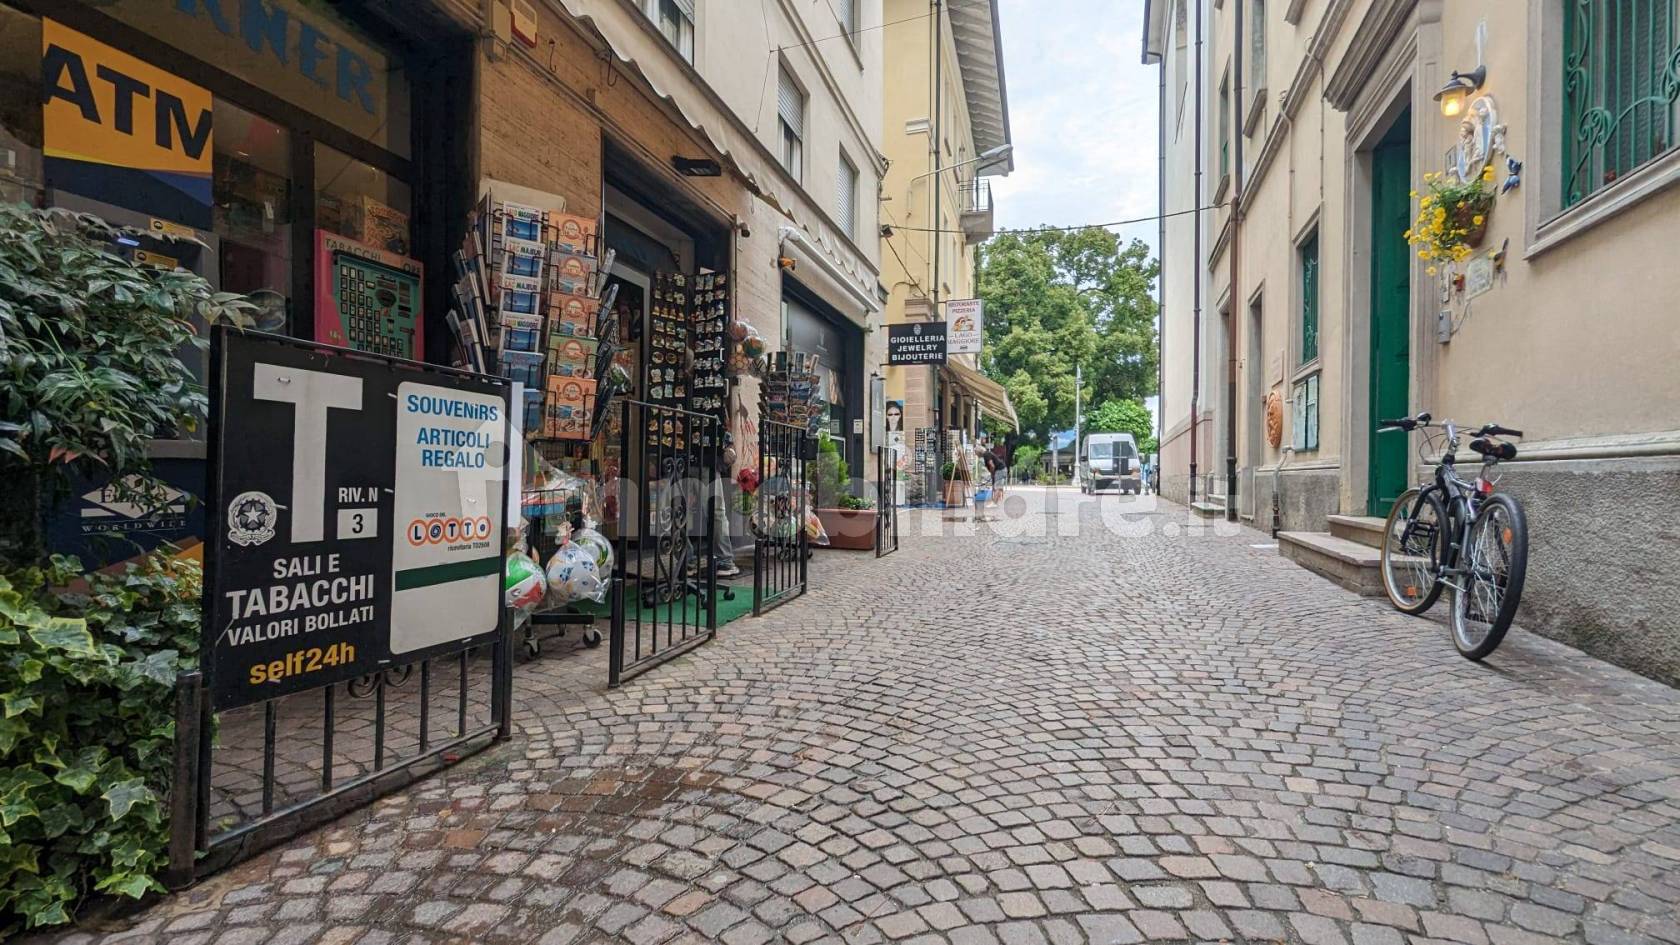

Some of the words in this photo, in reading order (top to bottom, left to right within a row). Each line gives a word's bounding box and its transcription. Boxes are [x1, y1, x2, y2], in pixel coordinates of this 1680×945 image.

[890, 334, 945, 344] GIOIELLERIA
[897, 344, 938, 352] JEWELRY
[891, 352, 944, 361] BIJOUTERIE
[416, 427, 490, 449] ARTICOLI
[253, 361, 364, 543] T
[421, 449, 485, 469] REGALO
[338, 487, 365, 503] RIV.
[368, 487, 379, 502] N
[351, 513, 364, 534] 3
[409, 519, 489, 544] LOTTO
[273, 555, 321, 579] SALI
[328, 553, 341, 573] E
[225, 574, 374, 620] TABACCHI
[227, 617, 299, 647] VALORI
[304, 605, 374, 633] BOLLATI
[249, 641, 355, 685] self24h
